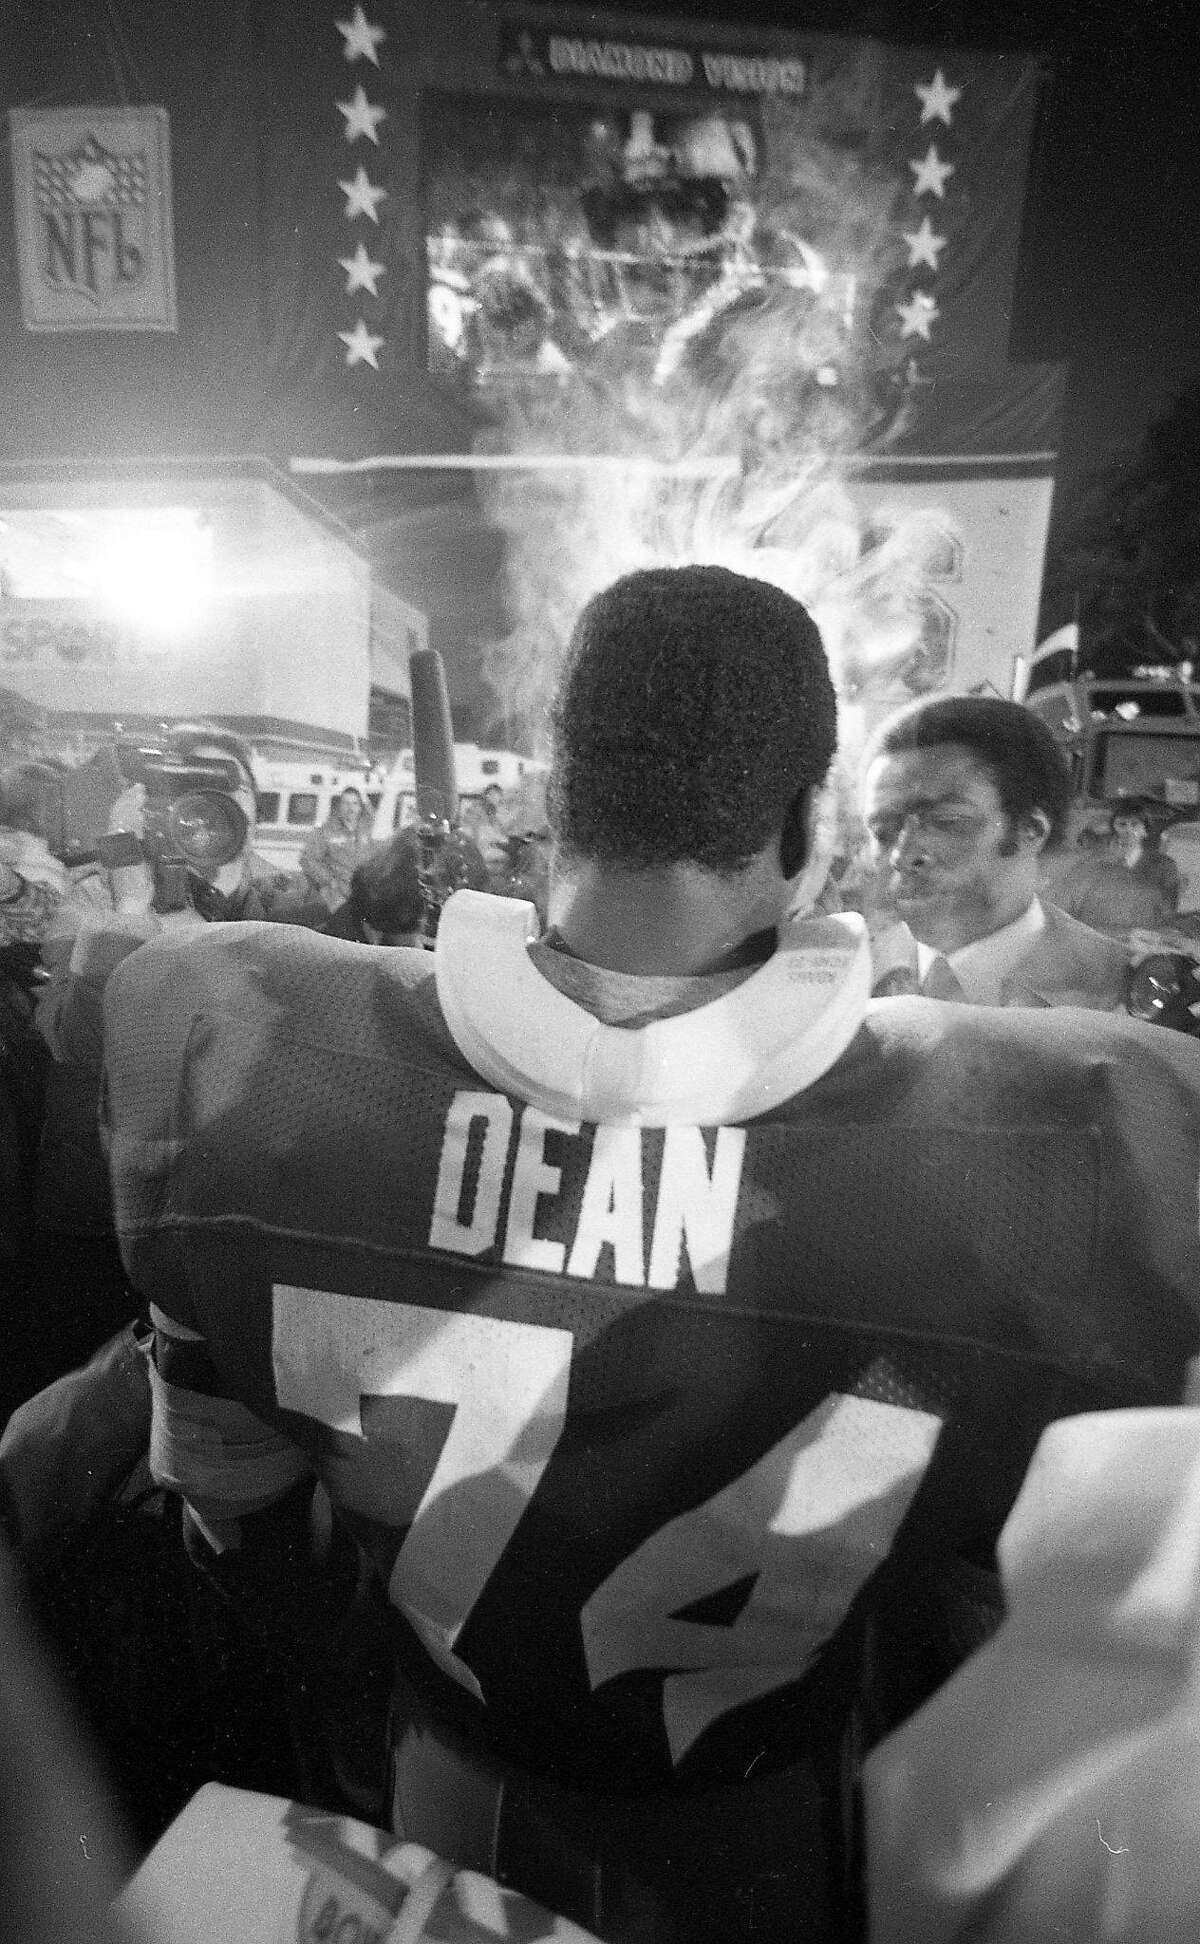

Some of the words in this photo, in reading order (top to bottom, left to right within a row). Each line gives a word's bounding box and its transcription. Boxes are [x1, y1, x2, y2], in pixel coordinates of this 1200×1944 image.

[40, 209, 144, 292] NFL
[428, 1090, 746, 1295] DEAN
[272, 1284, 943, 1767] 74
